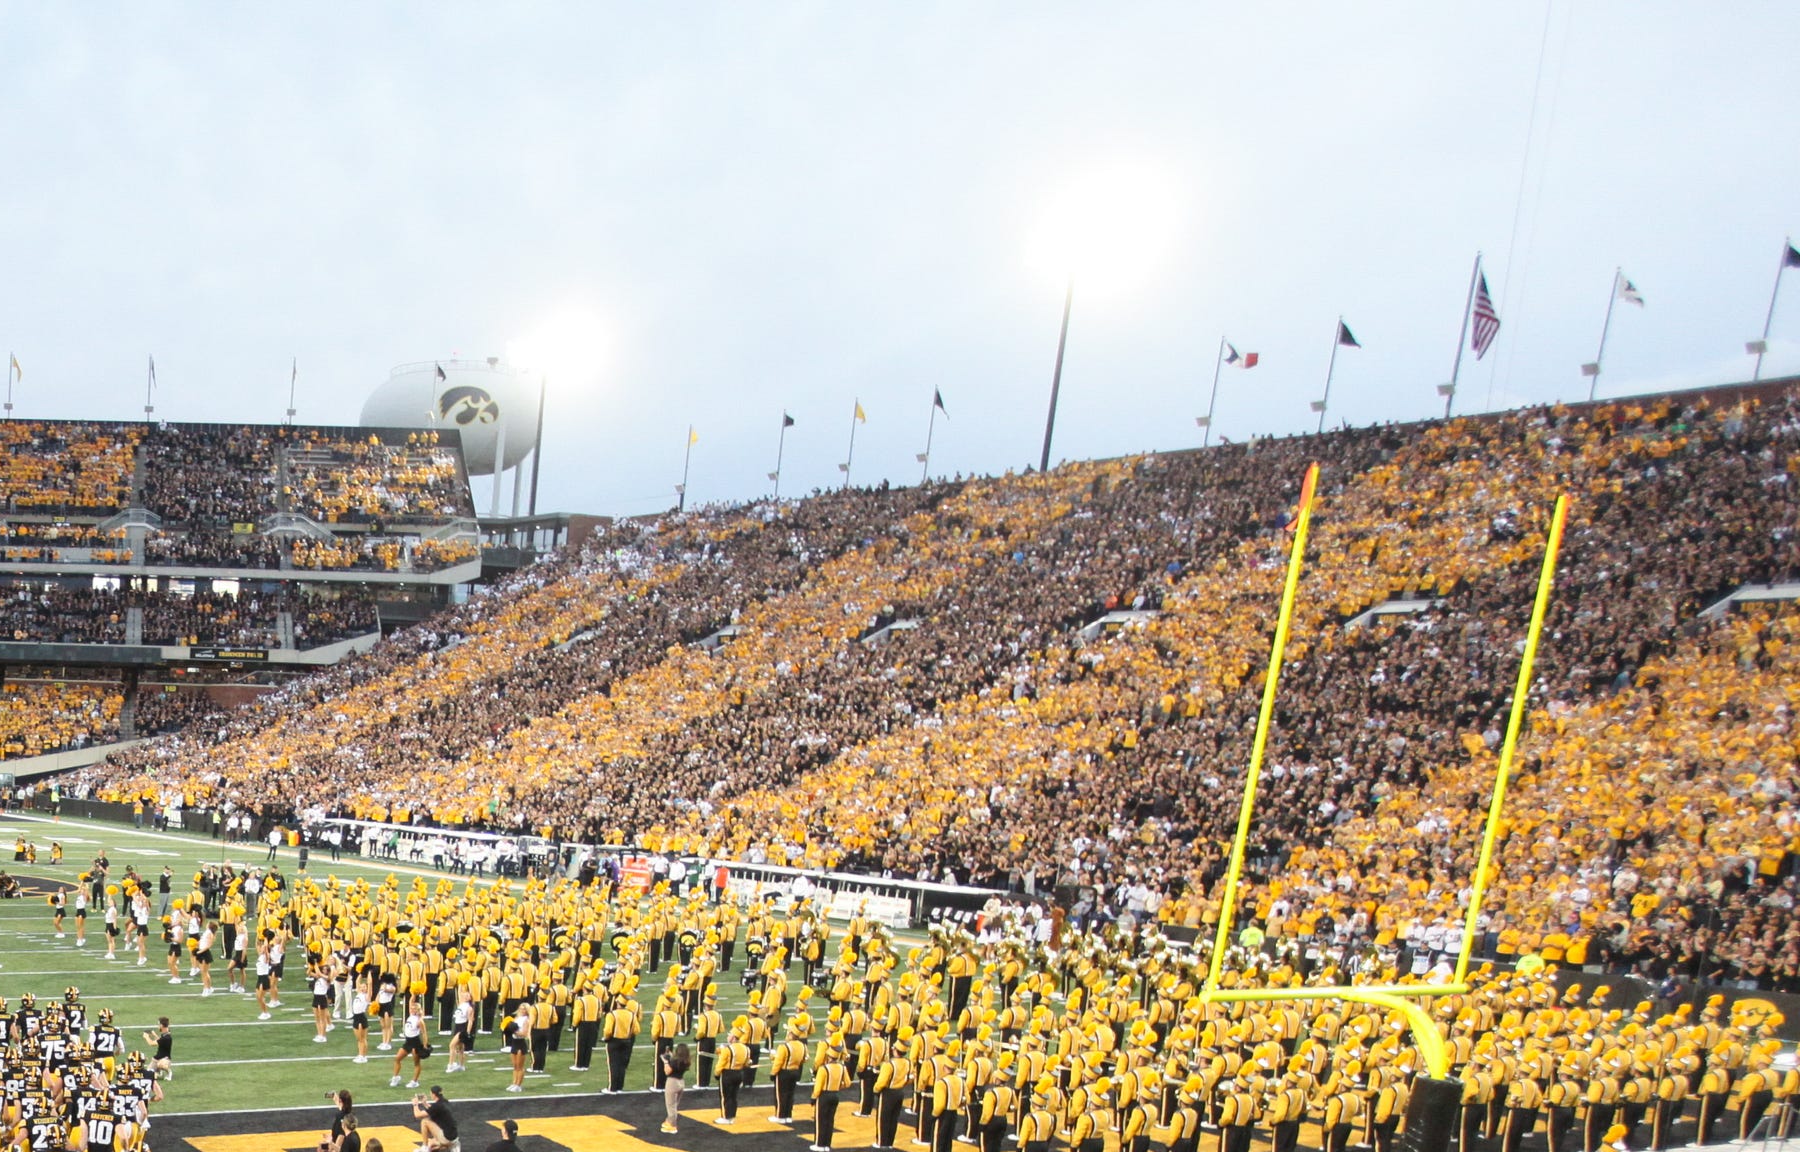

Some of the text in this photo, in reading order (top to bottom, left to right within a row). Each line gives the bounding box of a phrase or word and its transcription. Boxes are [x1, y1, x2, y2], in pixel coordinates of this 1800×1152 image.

[70, 1010, 81, 1028] 2
[40, 1040, 66, 1060] 75
[97, 1033, 116, 1052] 21
[77, 1097, 97, 1118] 14
[113, 1096, 138, 1117] 83
[89, 1120, 113, 1145] 10
